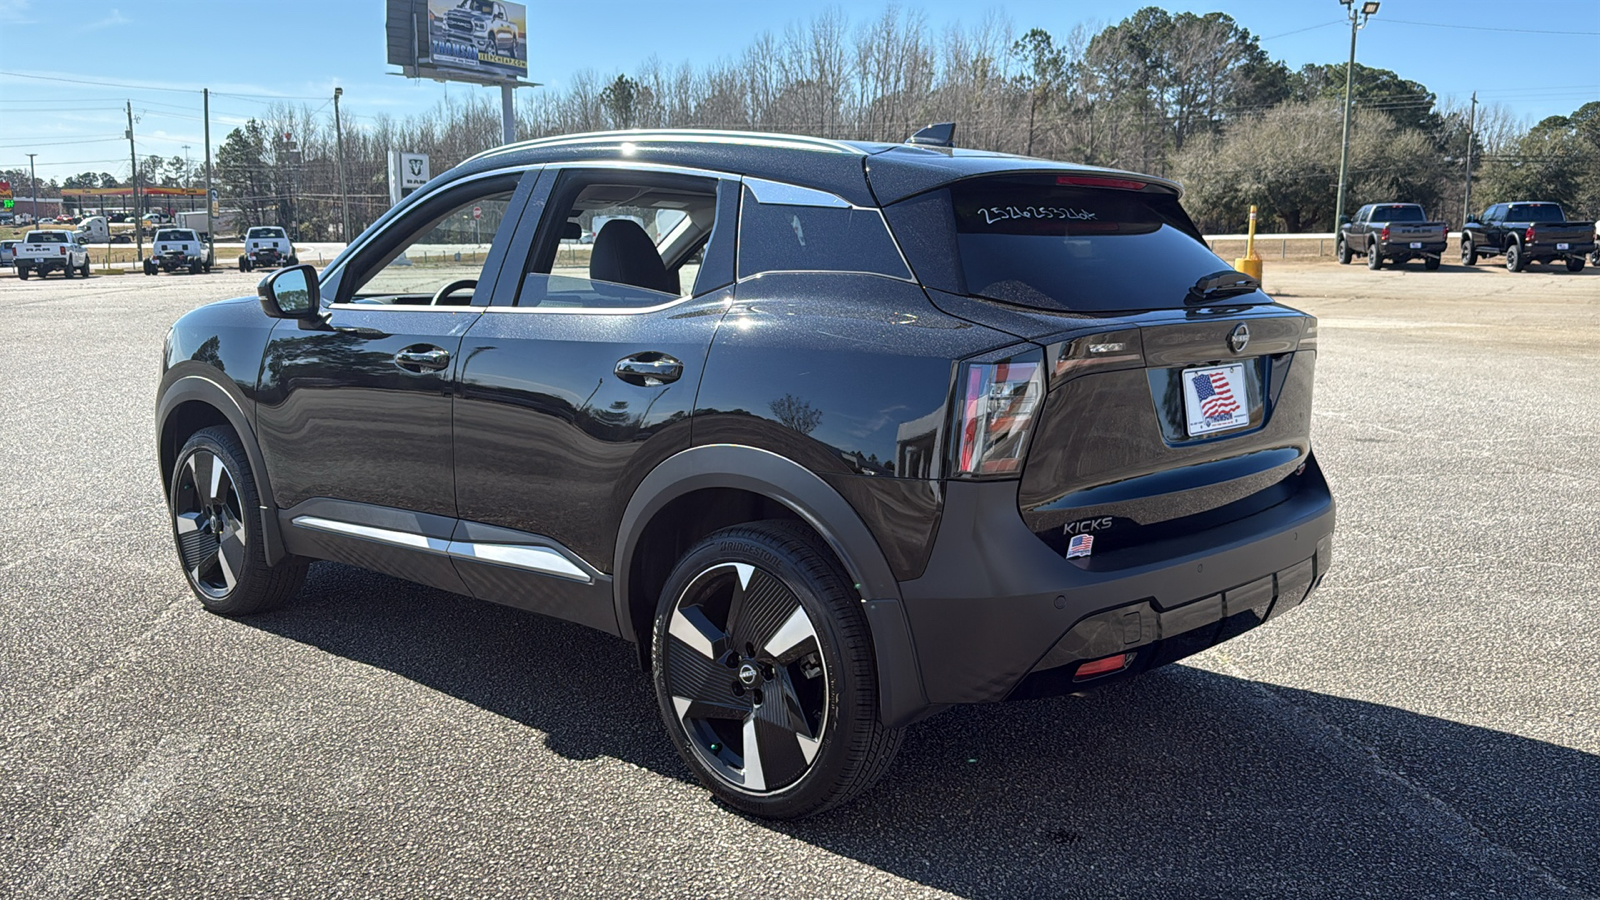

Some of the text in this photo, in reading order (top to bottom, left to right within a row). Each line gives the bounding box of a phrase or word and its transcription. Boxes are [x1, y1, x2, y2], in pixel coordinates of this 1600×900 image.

[433, 40, 479, 60] THOMSON
[1063, 517, 1113, 535] KICKS
[720, 541, 783, 569] BRIDGESTONE
